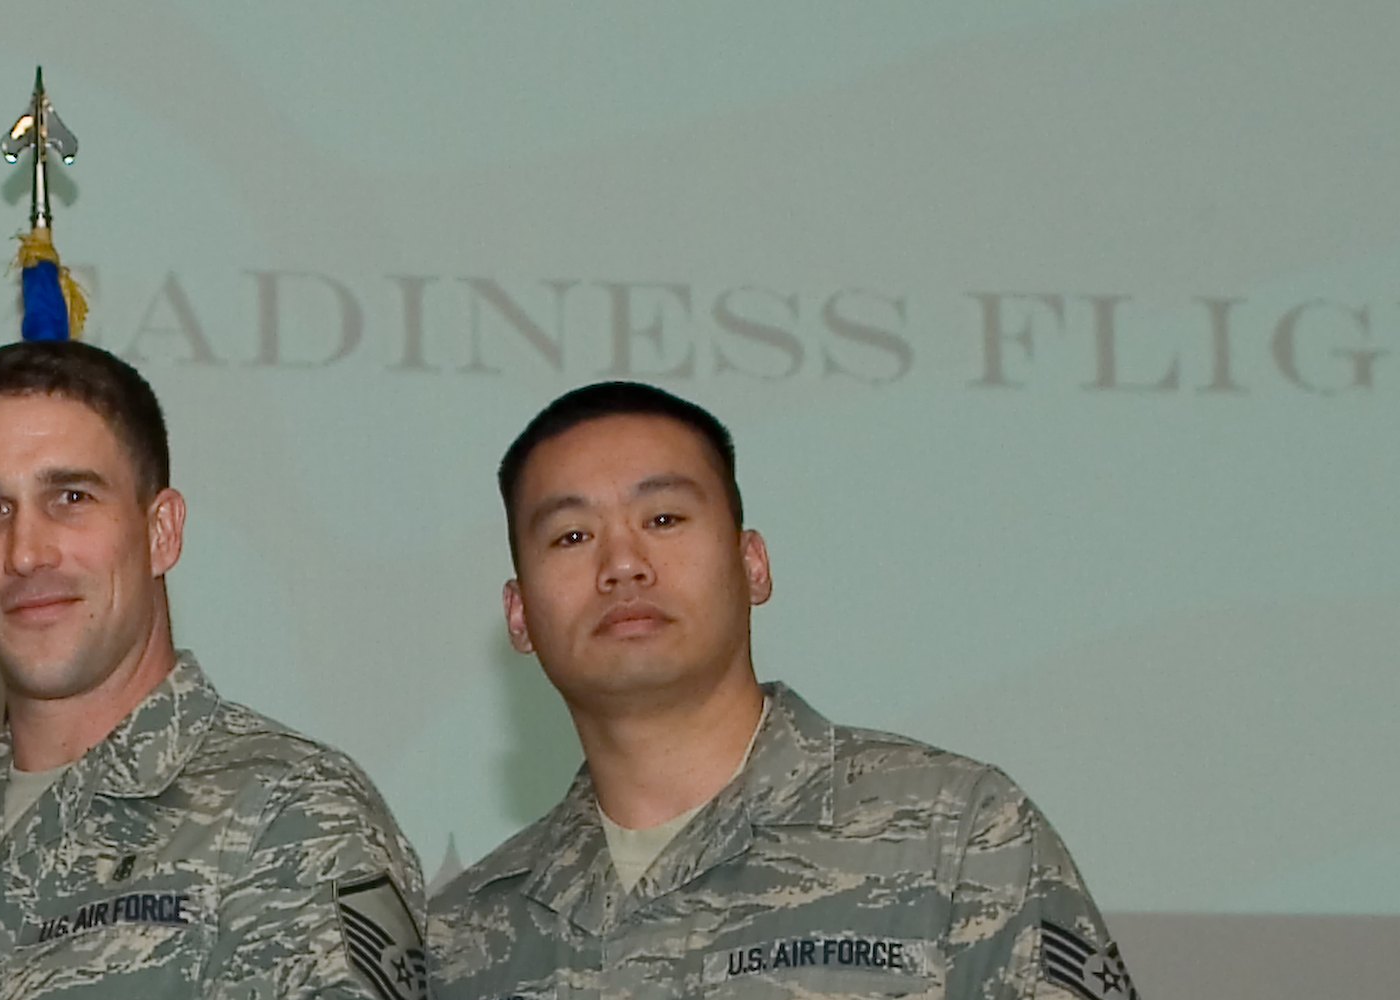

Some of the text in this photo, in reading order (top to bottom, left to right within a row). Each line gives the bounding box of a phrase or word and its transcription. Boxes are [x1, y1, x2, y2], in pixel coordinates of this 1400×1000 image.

[961, 291, 1399, 397] FLIG
[72, 902, 108, 933] AIR
[113, 893, 190, 924] FORCE
[728, 939, 903, 976] U.S. AIR FORCE
